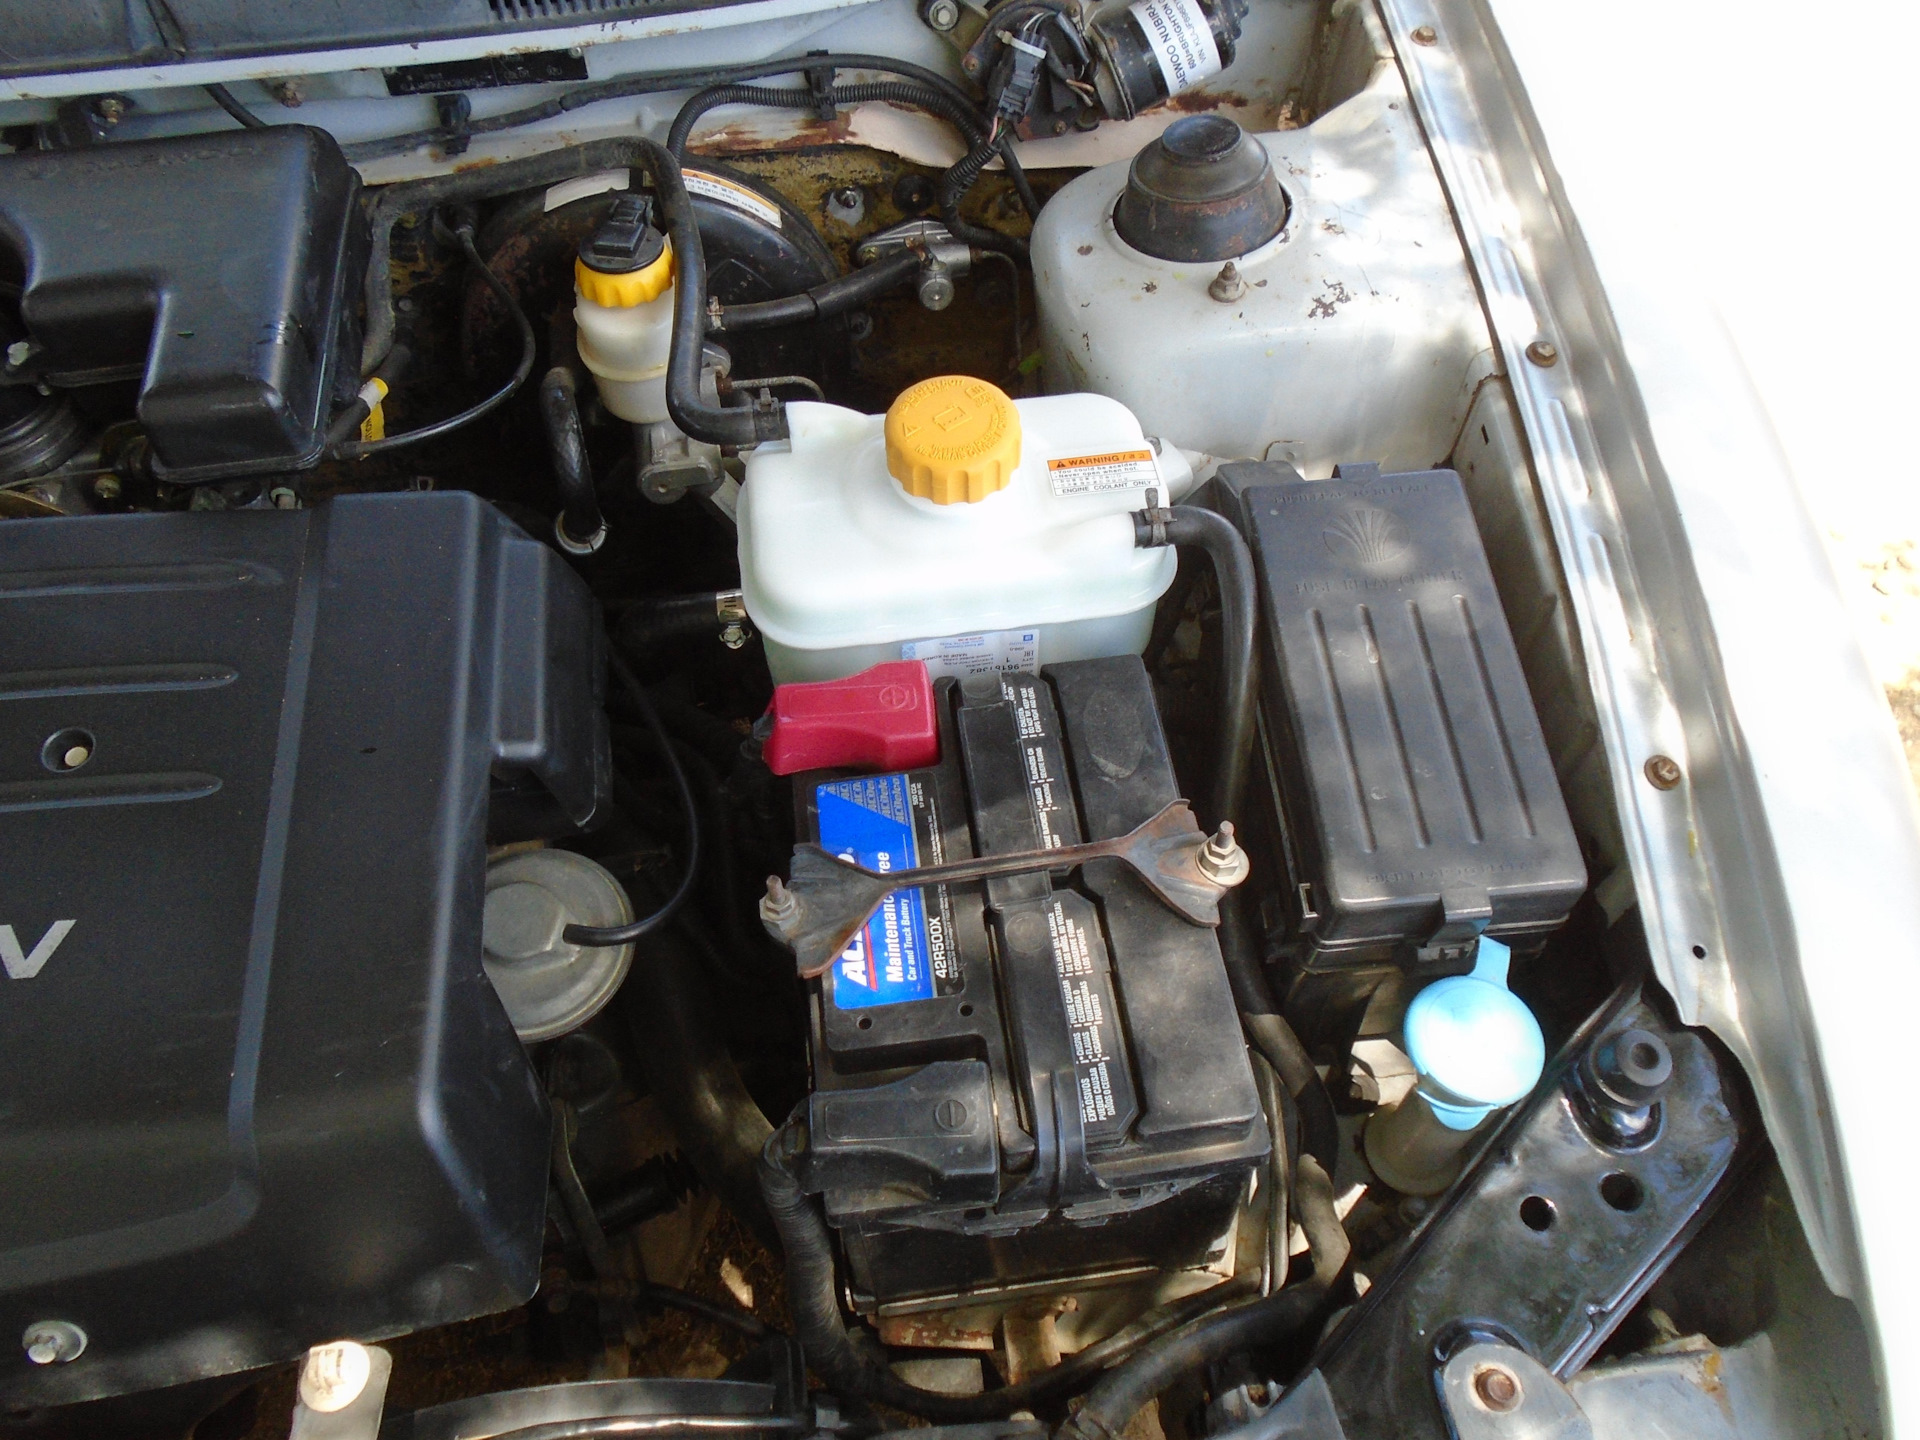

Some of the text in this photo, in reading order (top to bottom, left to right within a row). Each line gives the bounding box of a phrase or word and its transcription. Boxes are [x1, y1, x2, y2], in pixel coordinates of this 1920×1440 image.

[1145, 4, 1188, 88] DAEWOO NUBIRA
[1068, 455, 1120, 466] WARNING
[1062, 486, 1088, 494] ENGINE
[1093, 482, 1128, 491] COOLANT
[877, 852, 904, 983] Maintenanc ree
[900, 898, 917, 981] Car and Truck Battery
[928, 917, 948, 978] 42R500X
[1065, 918, 1083, 971] CONSERVE FIRME
[1063, 952, 1072, 964] LOS
[1065, 963, 1074, 972] DE
[1081, 956, 1091, 970] LOS
[1062, 979, 1078, 1024] PUEDE CAUSAR
[1074, 994, 1086, 1023] CEGUERA
[1079, 980, 1094, 1022] QUEMADURAS
[1090, 993, 1103, 1021] FUERTES
[1072, 1032, 1085, 1056] CHISPAS
[1081, 1031, 1093, 1055] FLAMAS
[1089, 1024, 1102, 1054] CIGARROS
[1097, 1061, 1110, 1090] CEGUERA
[1080, 1077, 1098, 1122] EXPLOSIVOS
[1089, 1067, 1107, 1121] PUEDEN CAUSAR
[1104, 1094, 1116, 1116] DAÑOS
